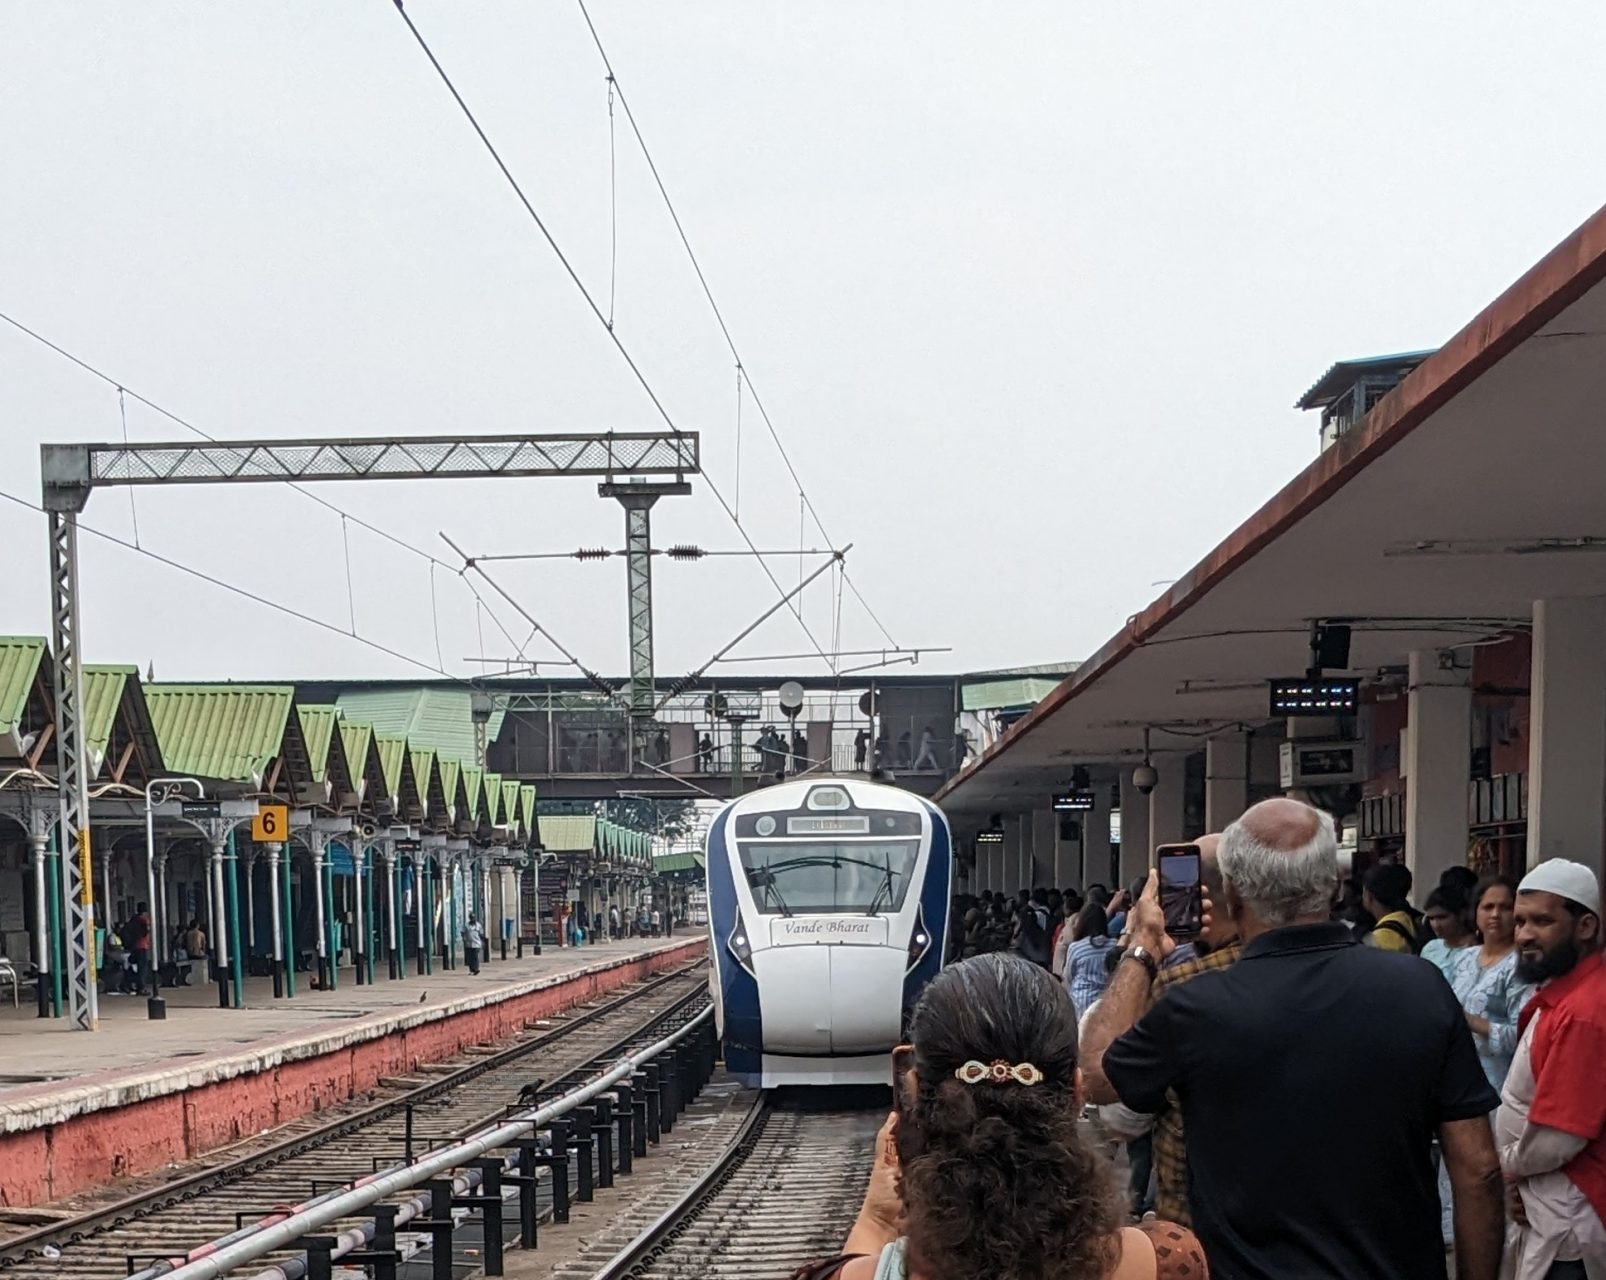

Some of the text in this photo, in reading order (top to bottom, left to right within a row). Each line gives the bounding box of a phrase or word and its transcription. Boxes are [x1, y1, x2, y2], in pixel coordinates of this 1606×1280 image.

[262, 812, 276, 834] 6
[785, 920, 869, 934] Vande Bharat
